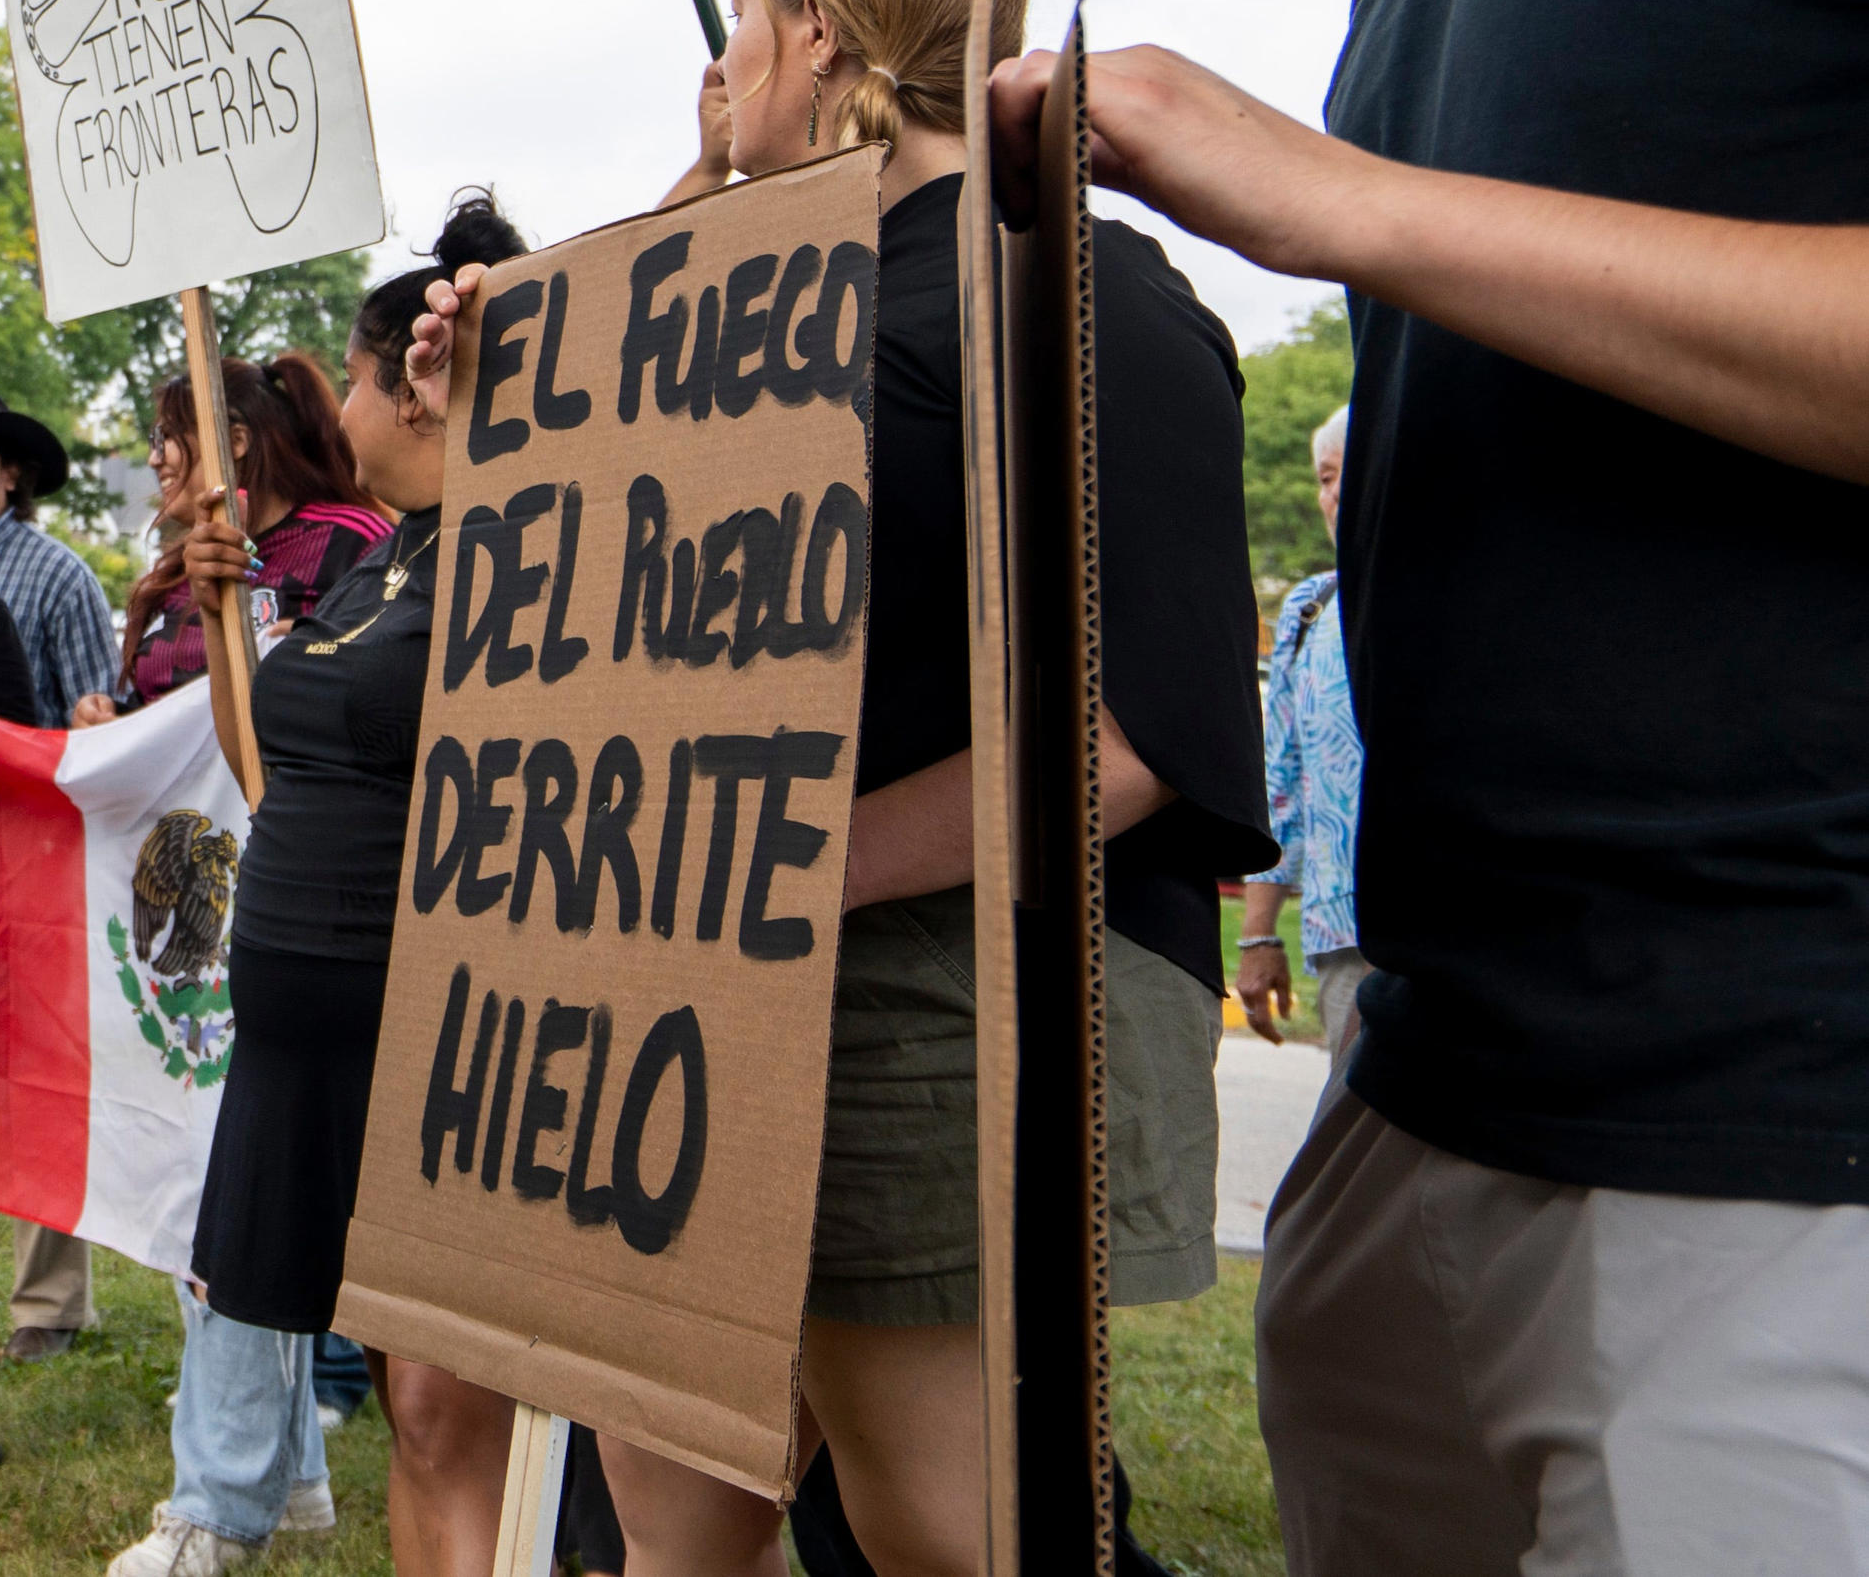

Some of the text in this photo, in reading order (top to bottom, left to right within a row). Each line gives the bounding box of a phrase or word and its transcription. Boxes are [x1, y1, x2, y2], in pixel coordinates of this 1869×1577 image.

[75, 47, 299, 192] FRONTERAS
[467, 270, 592, 465] EL
[443, 480, 591, 694] DEL
[412, 724, 849, 961] DERRITE
[420, 962, 709, 1255] HIELO
